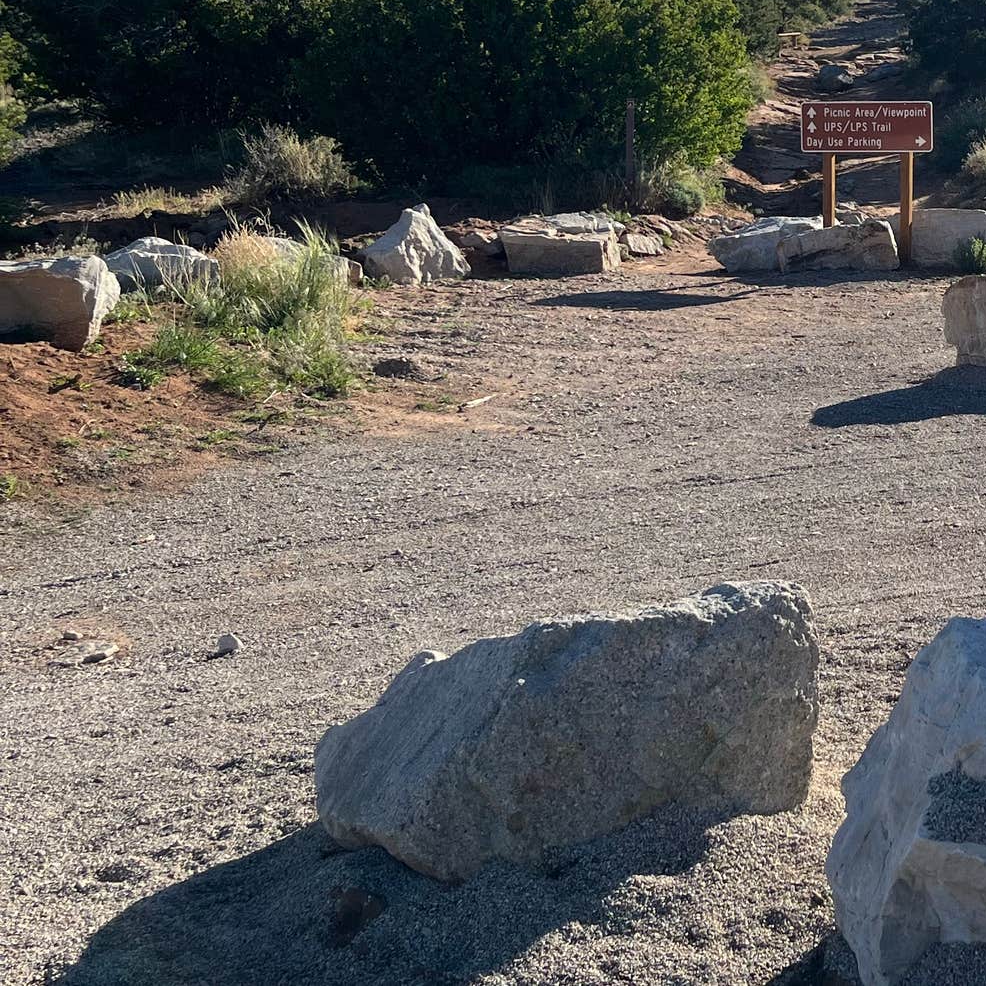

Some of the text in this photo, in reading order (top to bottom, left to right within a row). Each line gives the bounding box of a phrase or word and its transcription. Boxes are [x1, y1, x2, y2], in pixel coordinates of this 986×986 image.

[824, 105, 927, 118] Picnic Area/Viewpoint
[824, 120, 891, 133] UPS/LPS Trail
[806, 137, 882, 149] Day Use Parking
